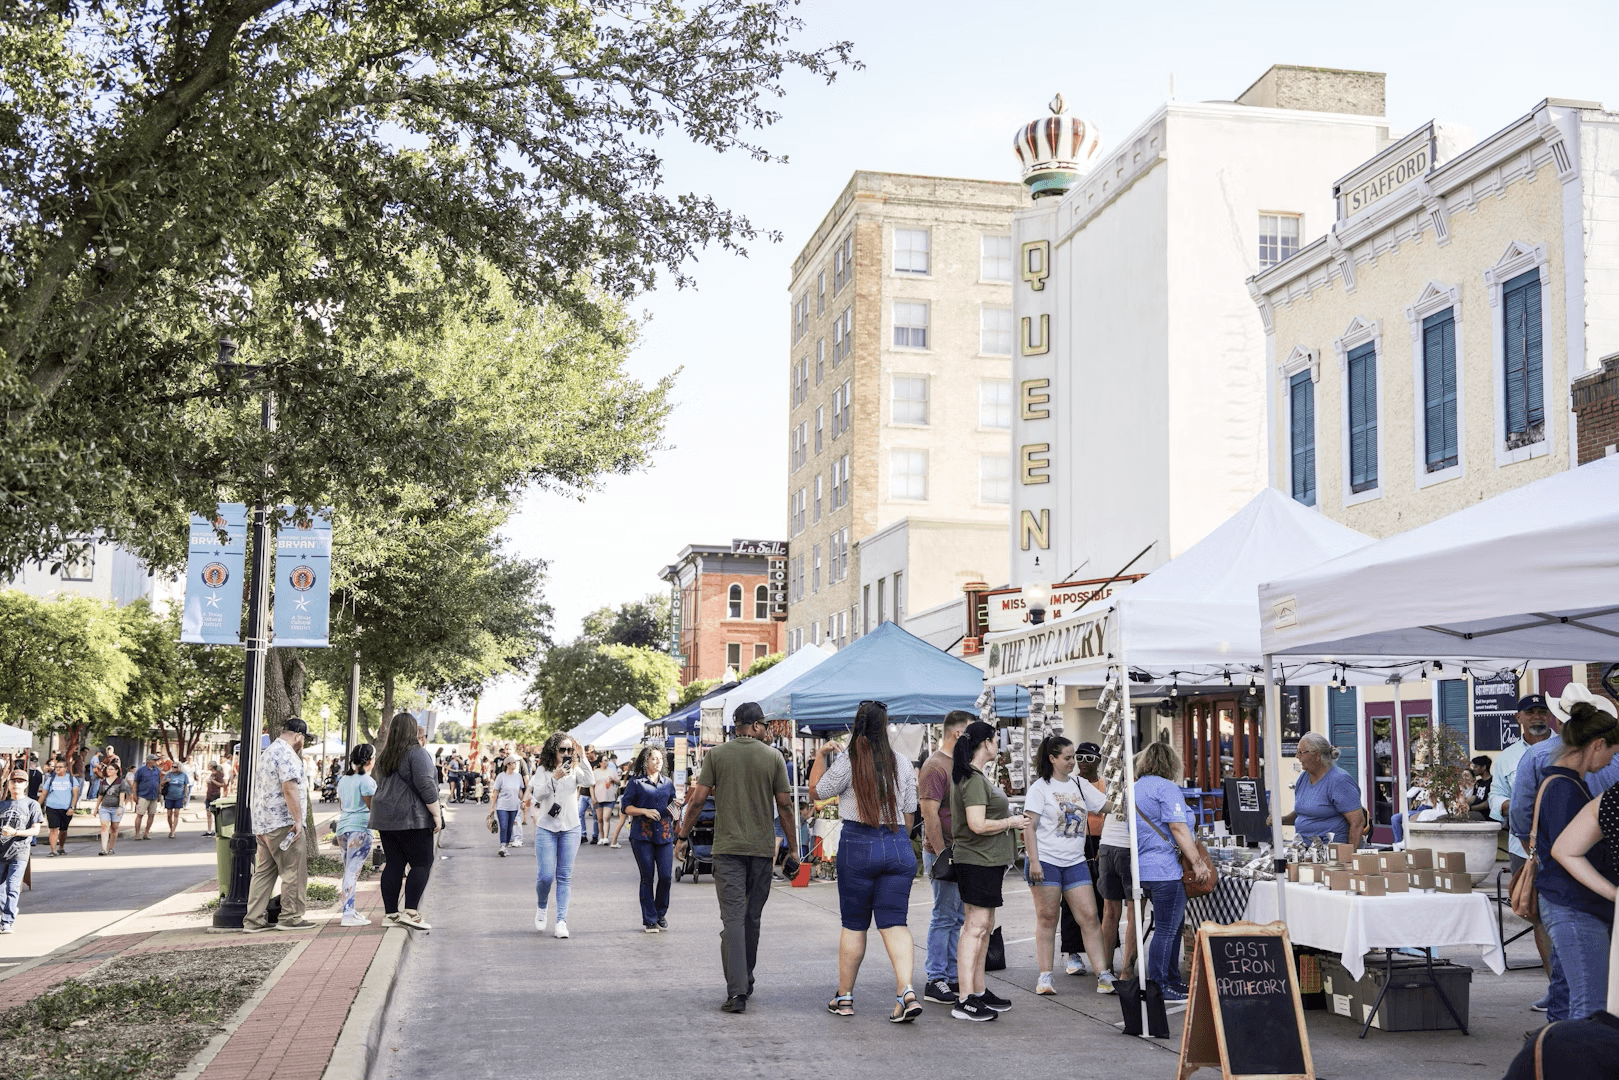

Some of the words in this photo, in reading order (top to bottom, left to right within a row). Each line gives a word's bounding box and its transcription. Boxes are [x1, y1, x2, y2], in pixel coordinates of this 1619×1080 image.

[1352, 152, 1426, 210] STAFFORD
[1021, 240, 1050, 551] QUEEN
[191, 536, 230, 545] BRYA
[756, 541, 787, 555] Salle
[775, 560, 785, 613] HOTEL
[672, 592, 680, 642] HOWELL
[1001, 639, 1026, 675] THE
[1025, 616, 1109, 670] PECANERY
[1225, 942, 1268, 958] CAST
[1226, 958, 1275, 974] IRON
[1217, 978, 1286, 996] APOTHECARY
